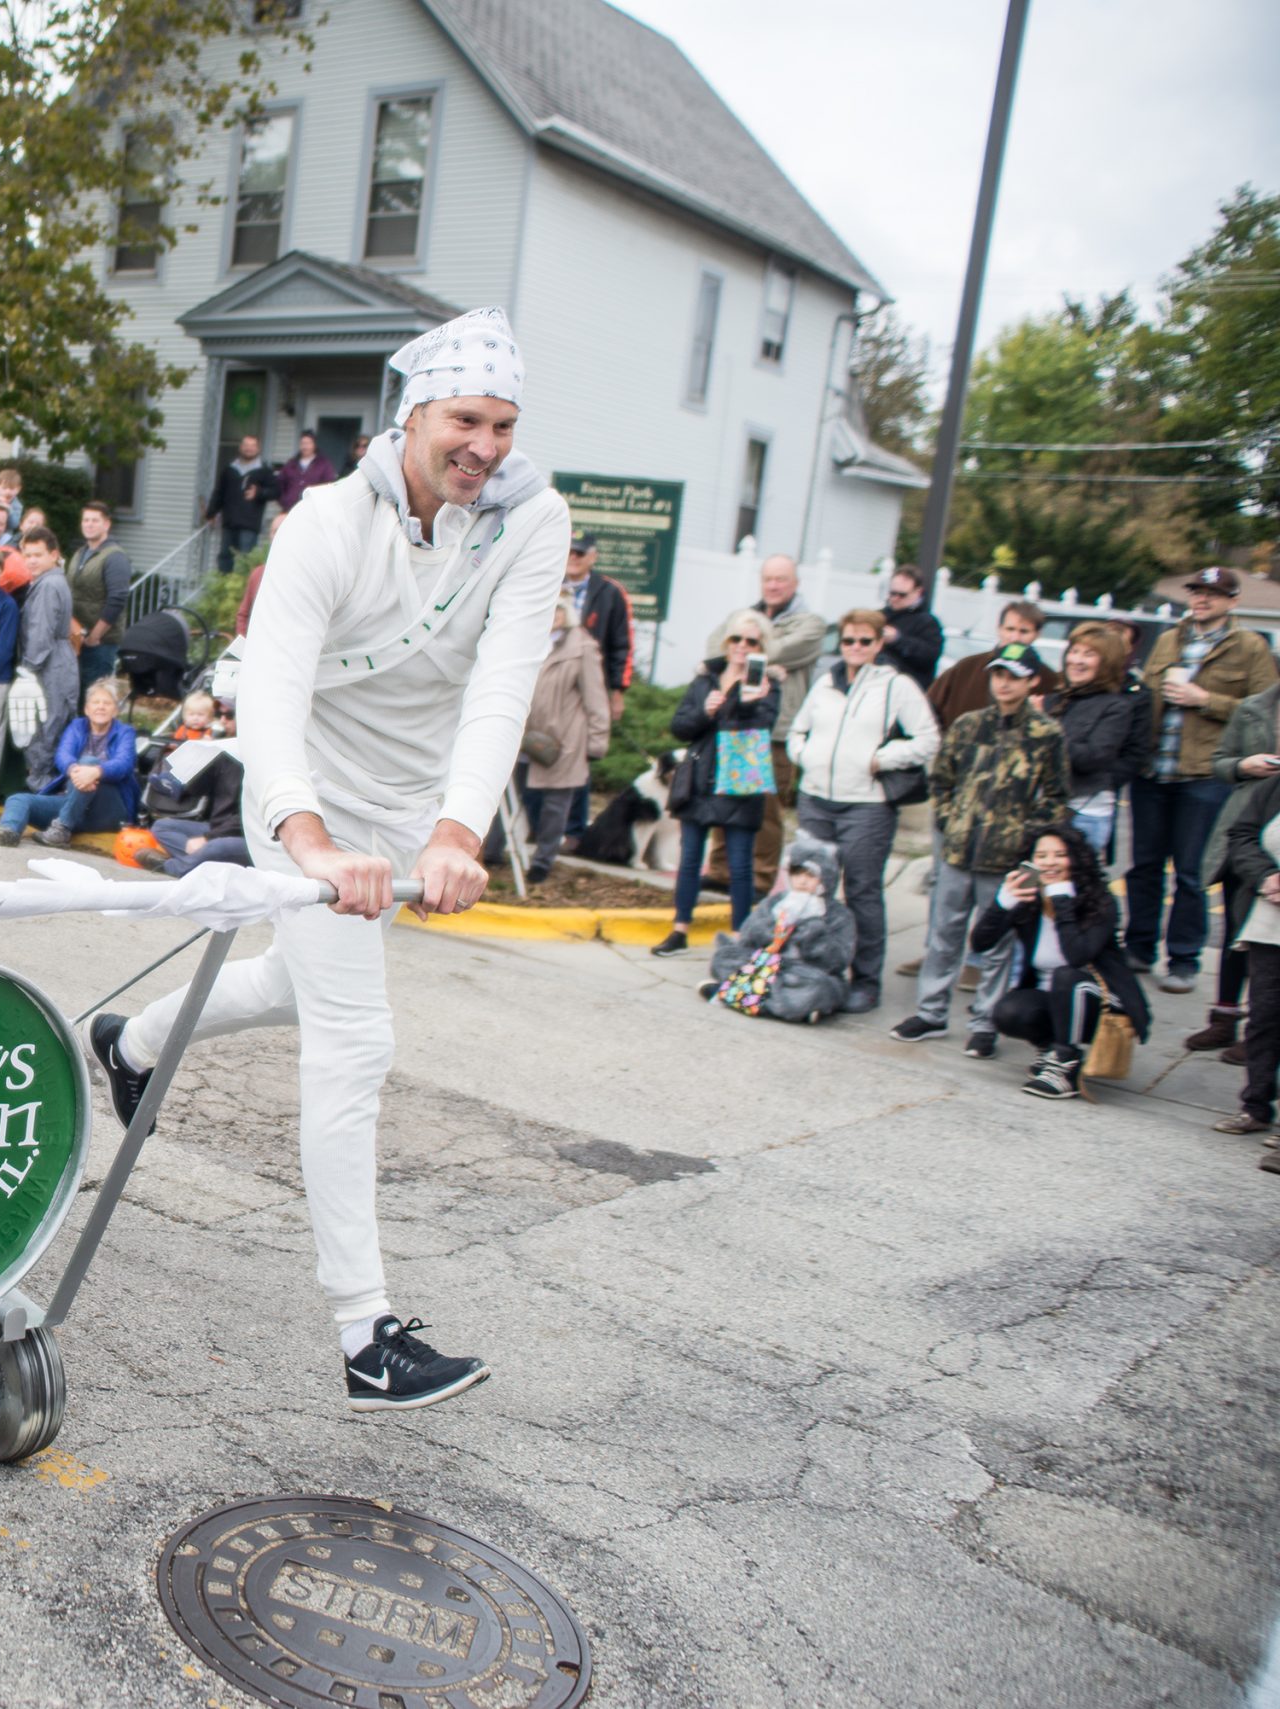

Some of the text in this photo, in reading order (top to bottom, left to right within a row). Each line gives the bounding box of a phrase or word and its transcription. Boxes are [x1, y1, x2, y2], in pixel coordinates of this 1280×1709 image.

[581, 481, 654, 499] Forest Park
[627, 496, 651, 510] Lot
[284, 1571, 465, 1650] STORM
